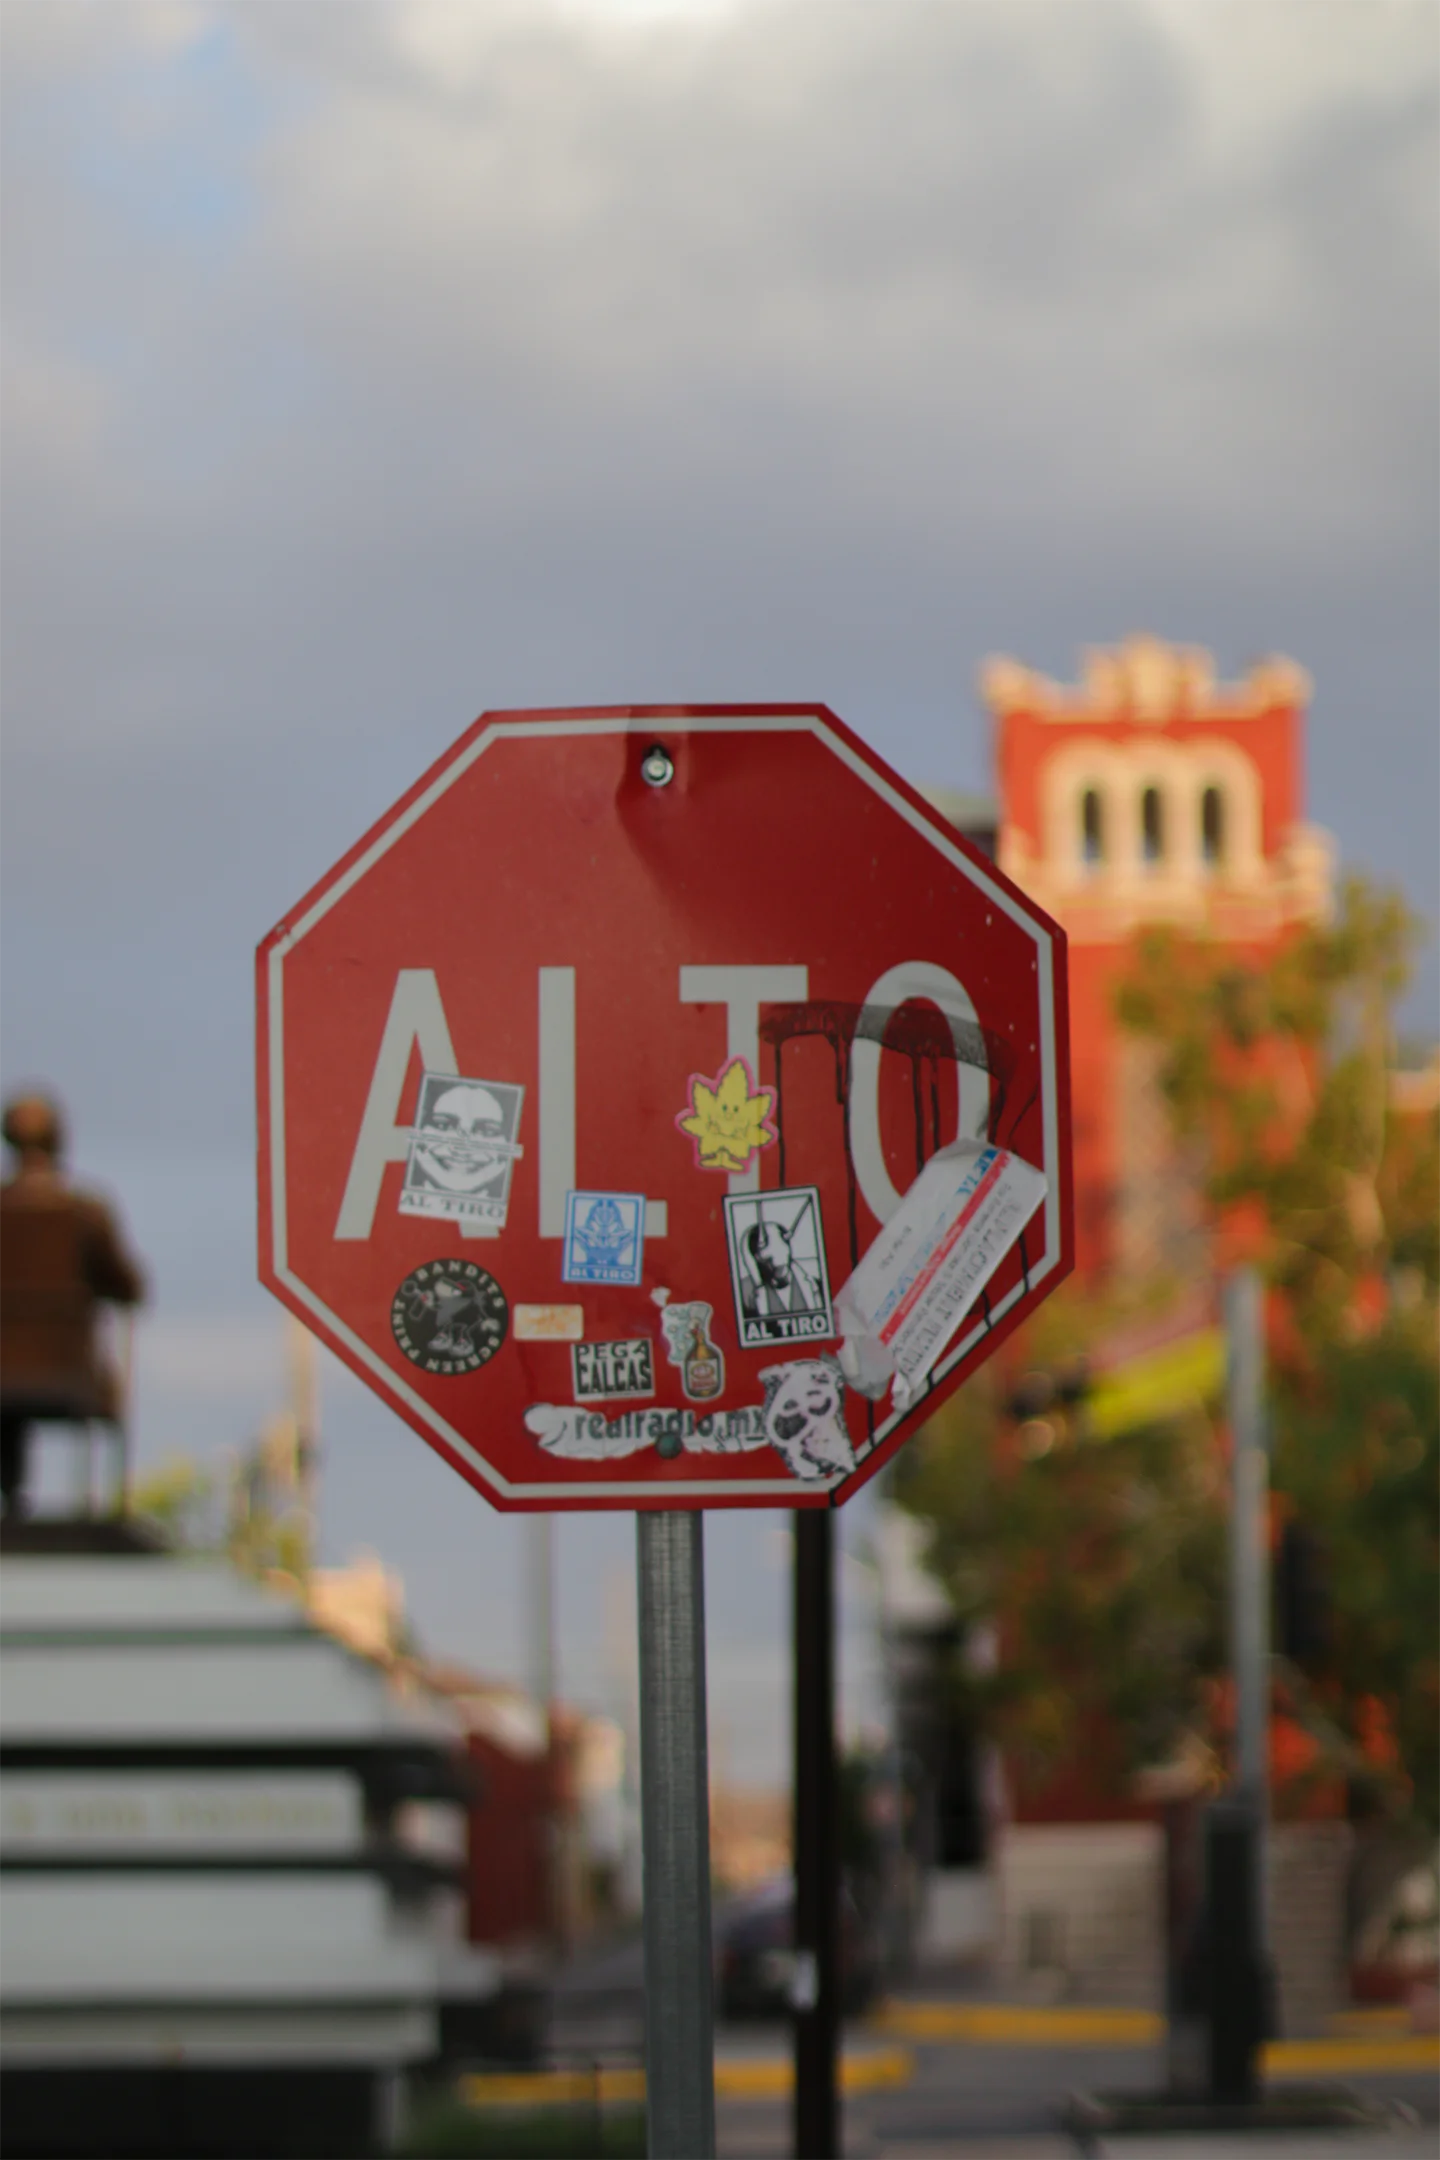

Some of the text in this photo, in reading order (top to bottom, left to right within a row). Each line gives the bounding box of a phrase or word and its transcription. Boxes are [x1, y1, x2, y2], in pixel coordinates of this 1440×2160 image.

[334, 961, 990, 1241] ALTO
[401, 1192, 506, 1220] AL TIRO
[416, 1260, 505, 1308] BANDITS
[393, 1299, 422, 1361] PRINT
[746, 1314, 828, 1340] AL TIRO
[426, 1336, 501, 1373] SCREEN
[576, 1340, 650, 1360] PEGA
[577, 1357, 653, 1394] CALCAS
